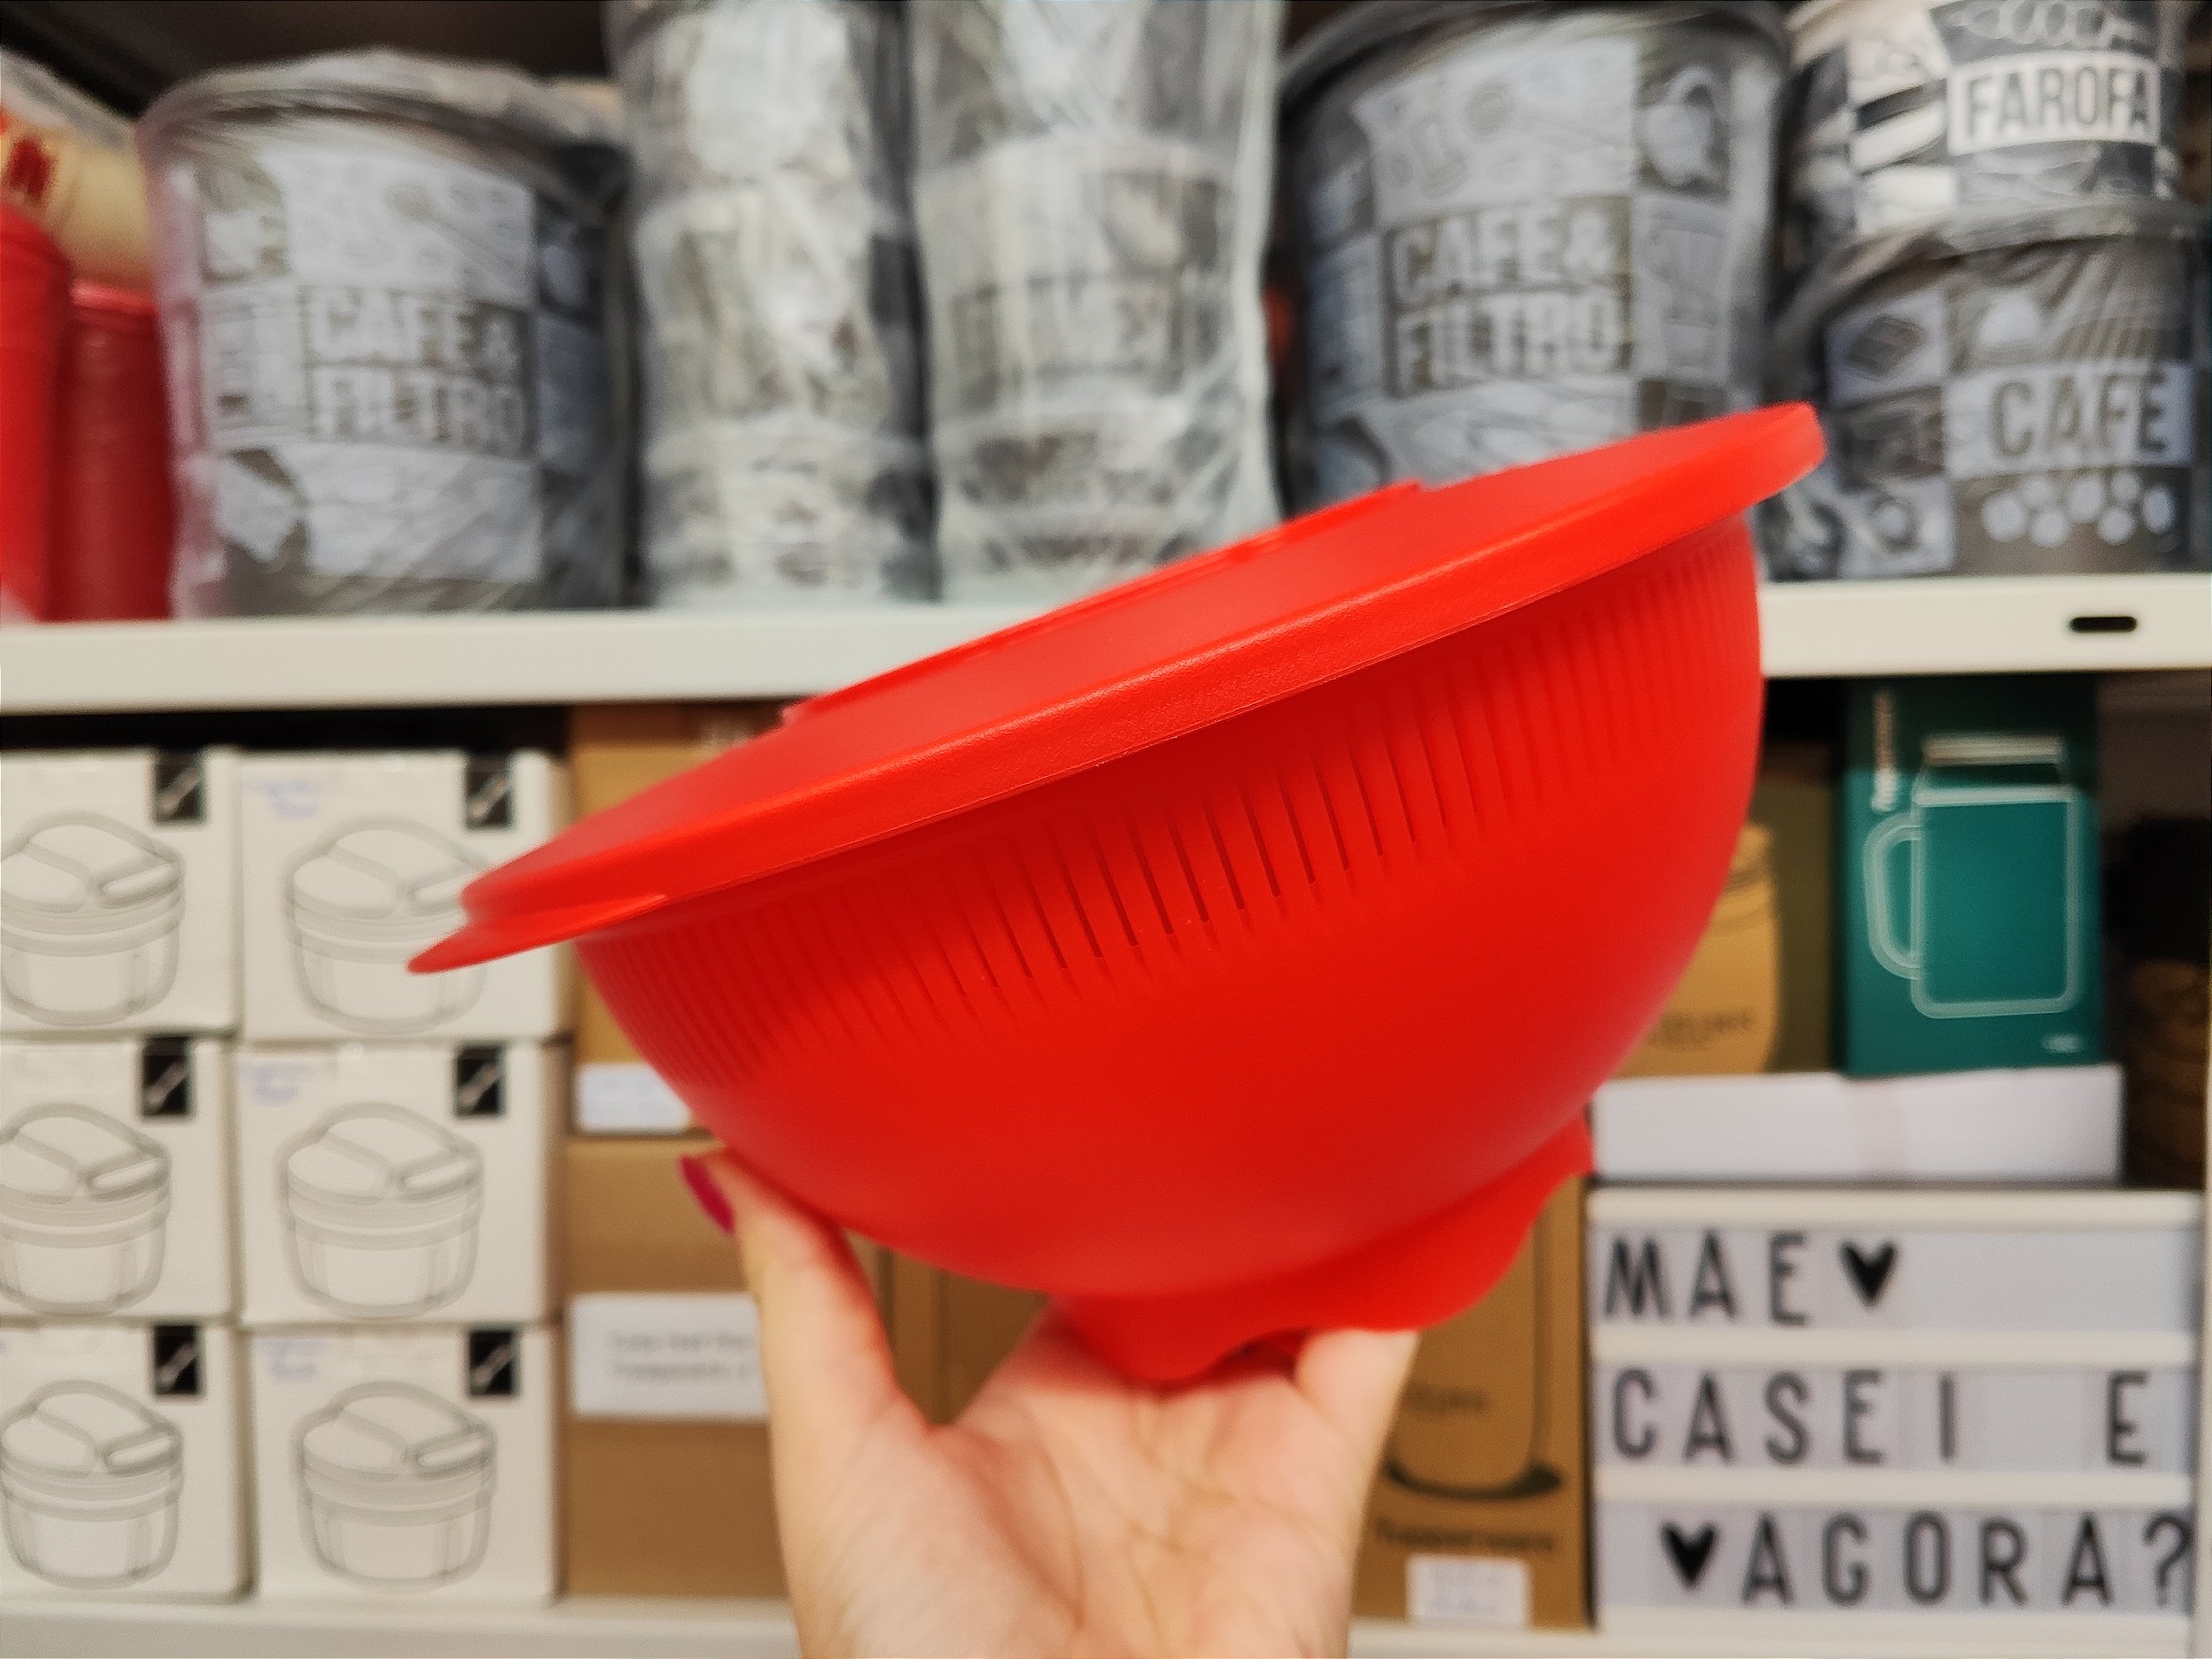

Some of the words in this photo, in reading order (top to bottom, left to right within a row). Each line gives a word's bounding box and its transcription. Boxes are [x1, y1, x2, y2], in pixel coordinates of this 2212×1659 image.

[1964, 65, 2150, 138] FAROFA
[1398, 288, 1621, 391] FILTRO
[1603, 1230, 1809, 1325] MAE
[1611, 1367, 1958, 1464] CASEI
[2103, 1369, 2148, 1465] E
[1740, 1509, 2192, 1608] AGORA?
